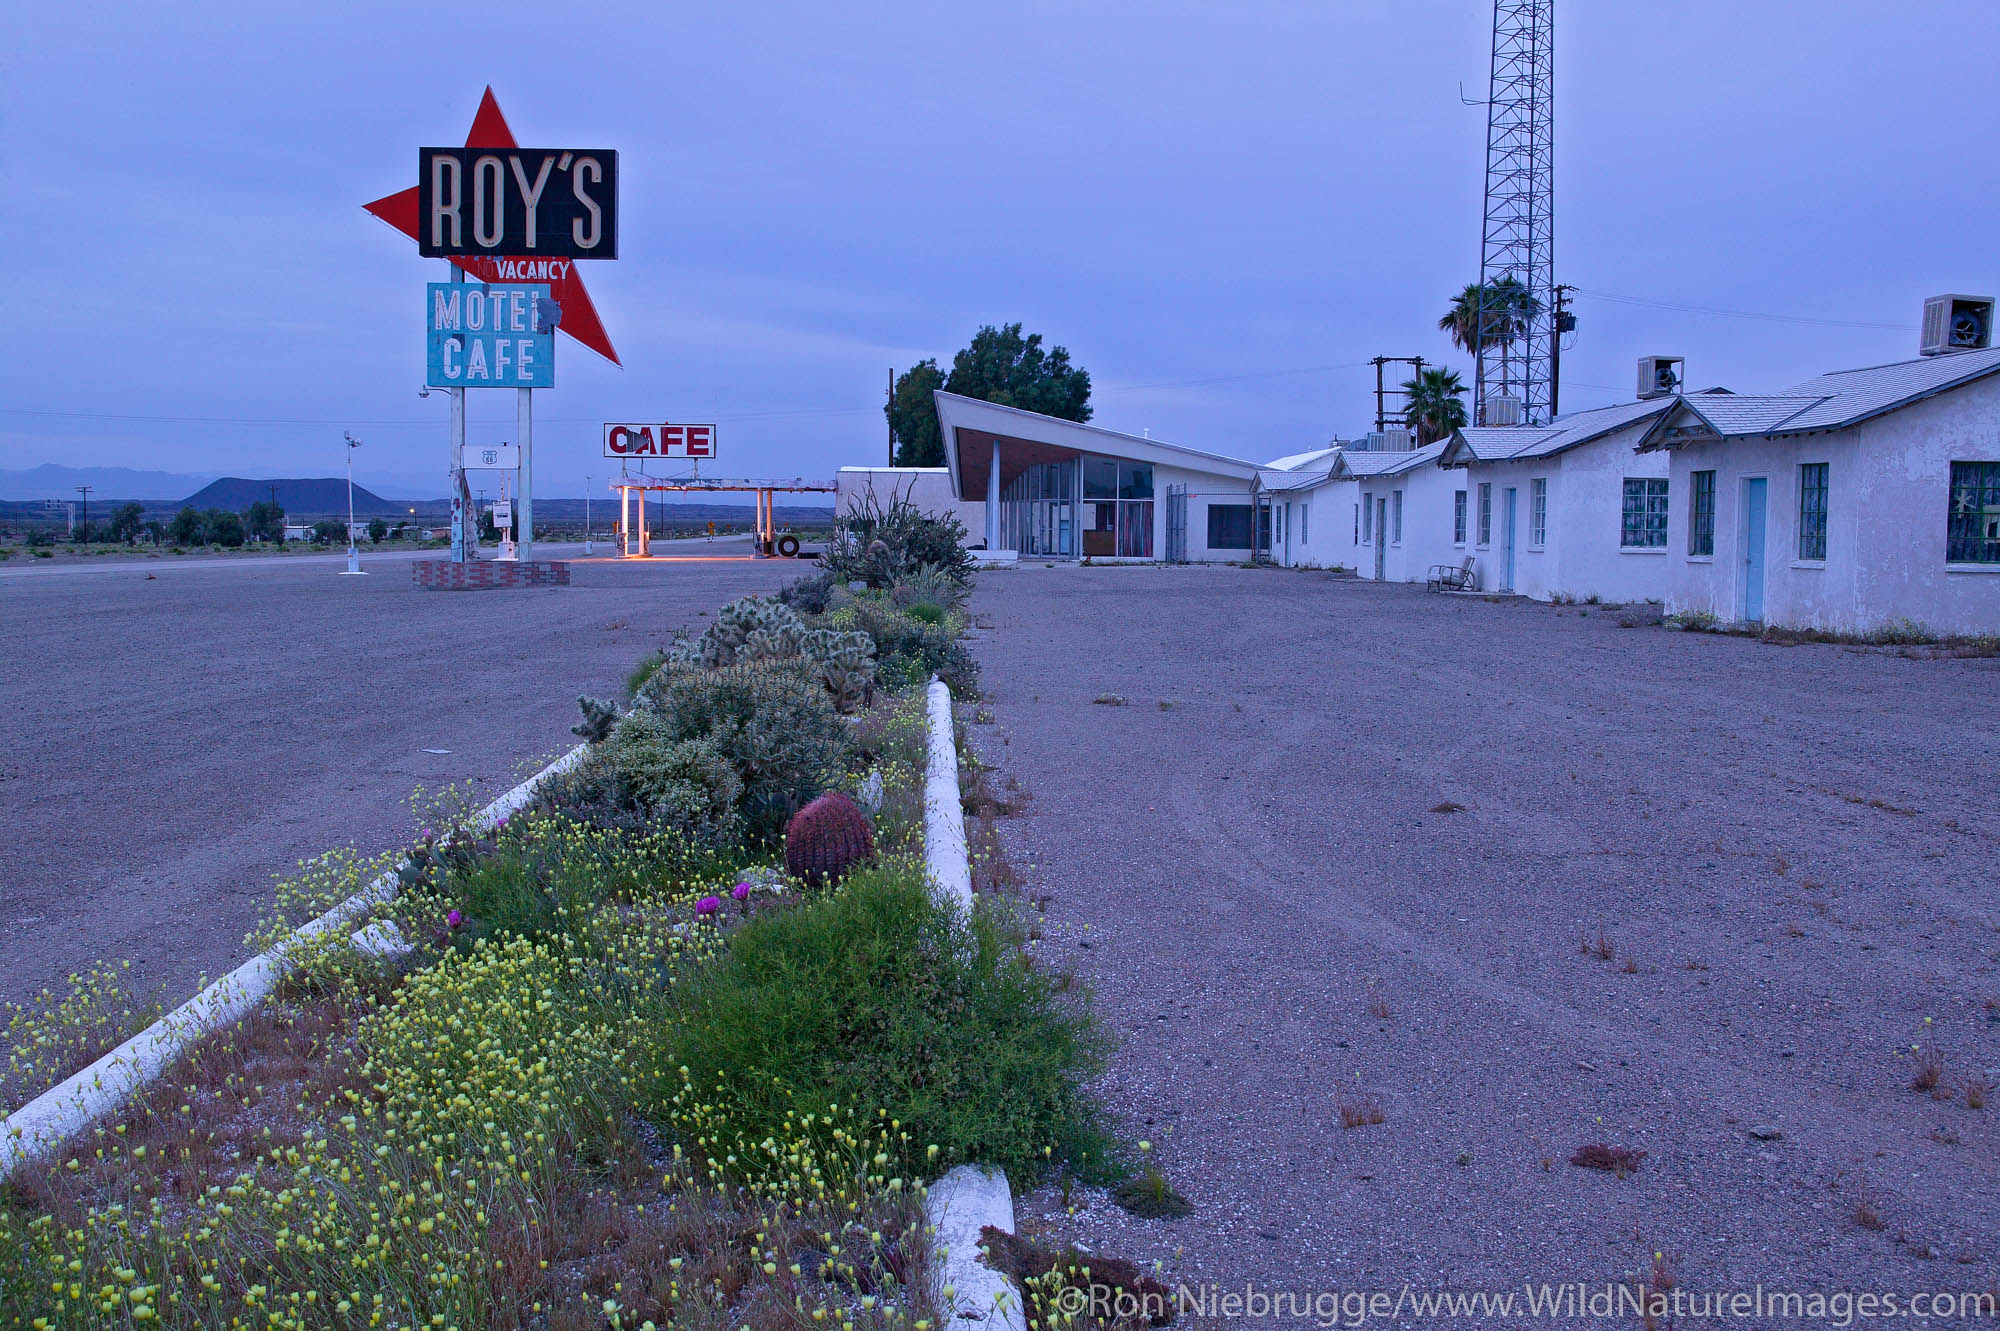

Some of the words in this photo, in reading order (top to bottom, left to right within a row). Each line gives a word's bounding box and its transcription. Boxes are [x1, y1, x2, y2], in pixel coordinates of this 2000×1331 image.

[431, 151, 602, 249] ROY'S
[496, 260, 570, 280] VACANCY
[443, 338, 534, 380] CAFE
[609, 426, 710, 456] CAFE
